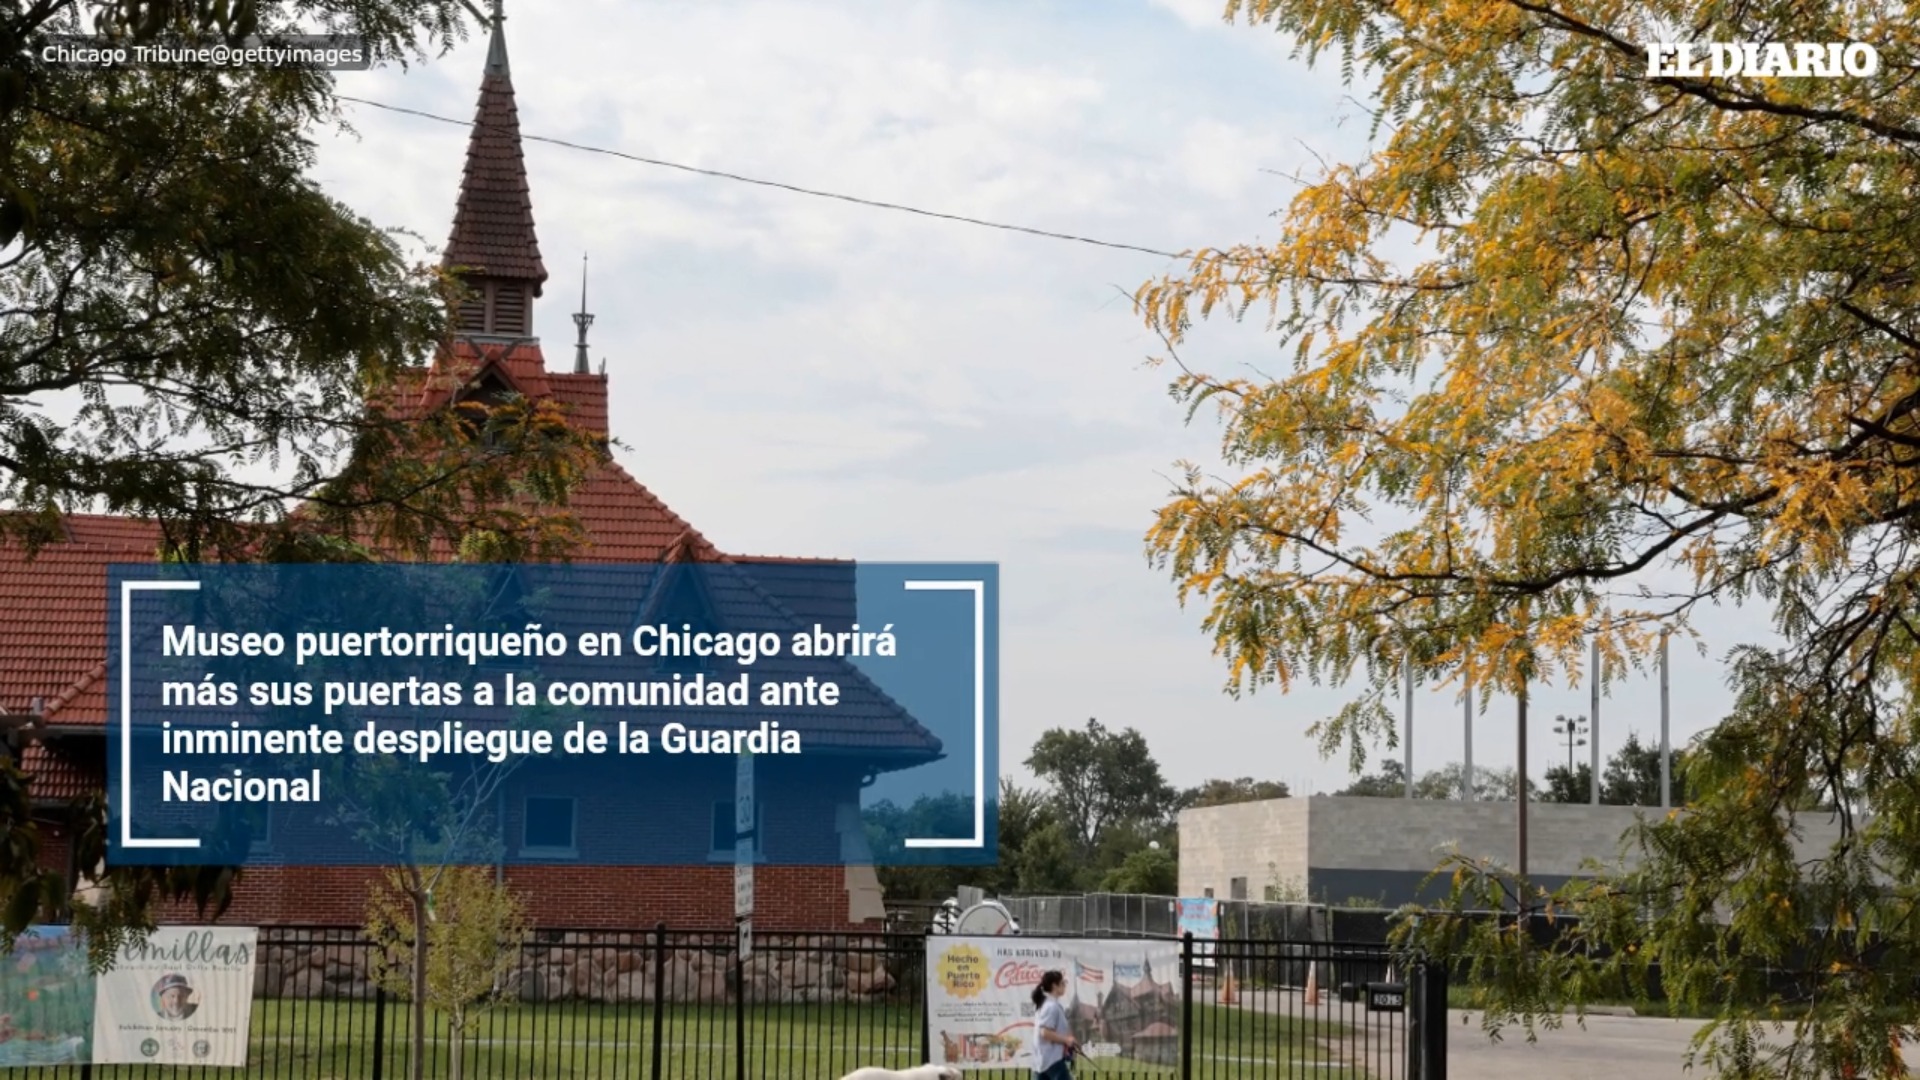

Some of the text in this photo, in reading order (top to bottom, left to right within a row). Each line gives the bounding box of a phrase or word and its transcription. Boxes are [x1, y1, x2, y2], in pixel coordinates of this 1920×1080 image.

[114, 930, 252, 965] emillas
[947, 955, 979, 964] Hecho
[946, 972, 980, 982] Puerto
[953, 980, 975, 988] Rico
